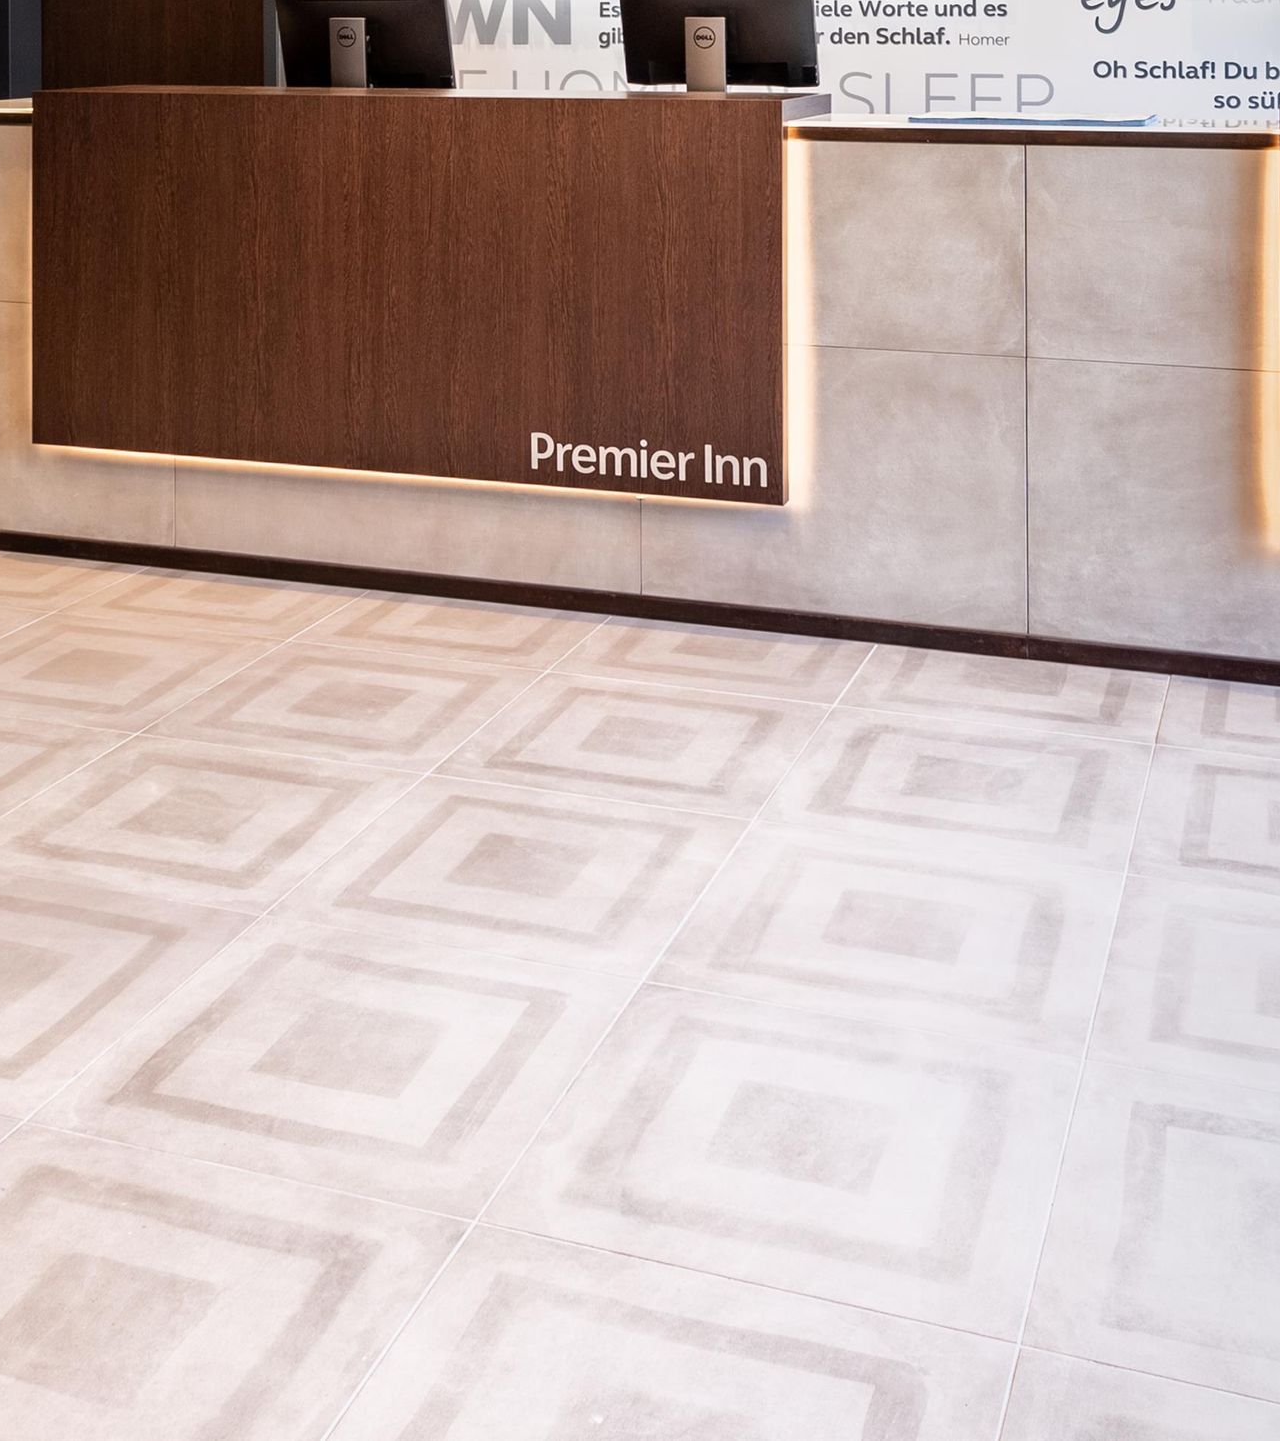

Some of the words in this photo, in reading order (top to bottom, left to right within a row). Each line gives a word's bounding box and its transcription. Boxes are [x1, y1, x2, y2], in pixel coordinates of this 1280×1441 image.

[600, 1, 621, 18] Es
[858, 0, 928, 18] Worte
[934, 0, 977, 17] und
[983, 4, 1008, 18] es
[830, 27, 870, 45] den
[876, 27, 950, 46] Schlaf.
[958, 33, 1010, 46] Homer
[1093, 61, 1127, 79] Oh
[1134, 61, 1216, 79] Schlaf!
[1224, 61, 1258, 79] Du
[1214, 95, 1241, 109] so
[530, 431, 695, 481] Premier
[704, 444, 768, 487] Inn
